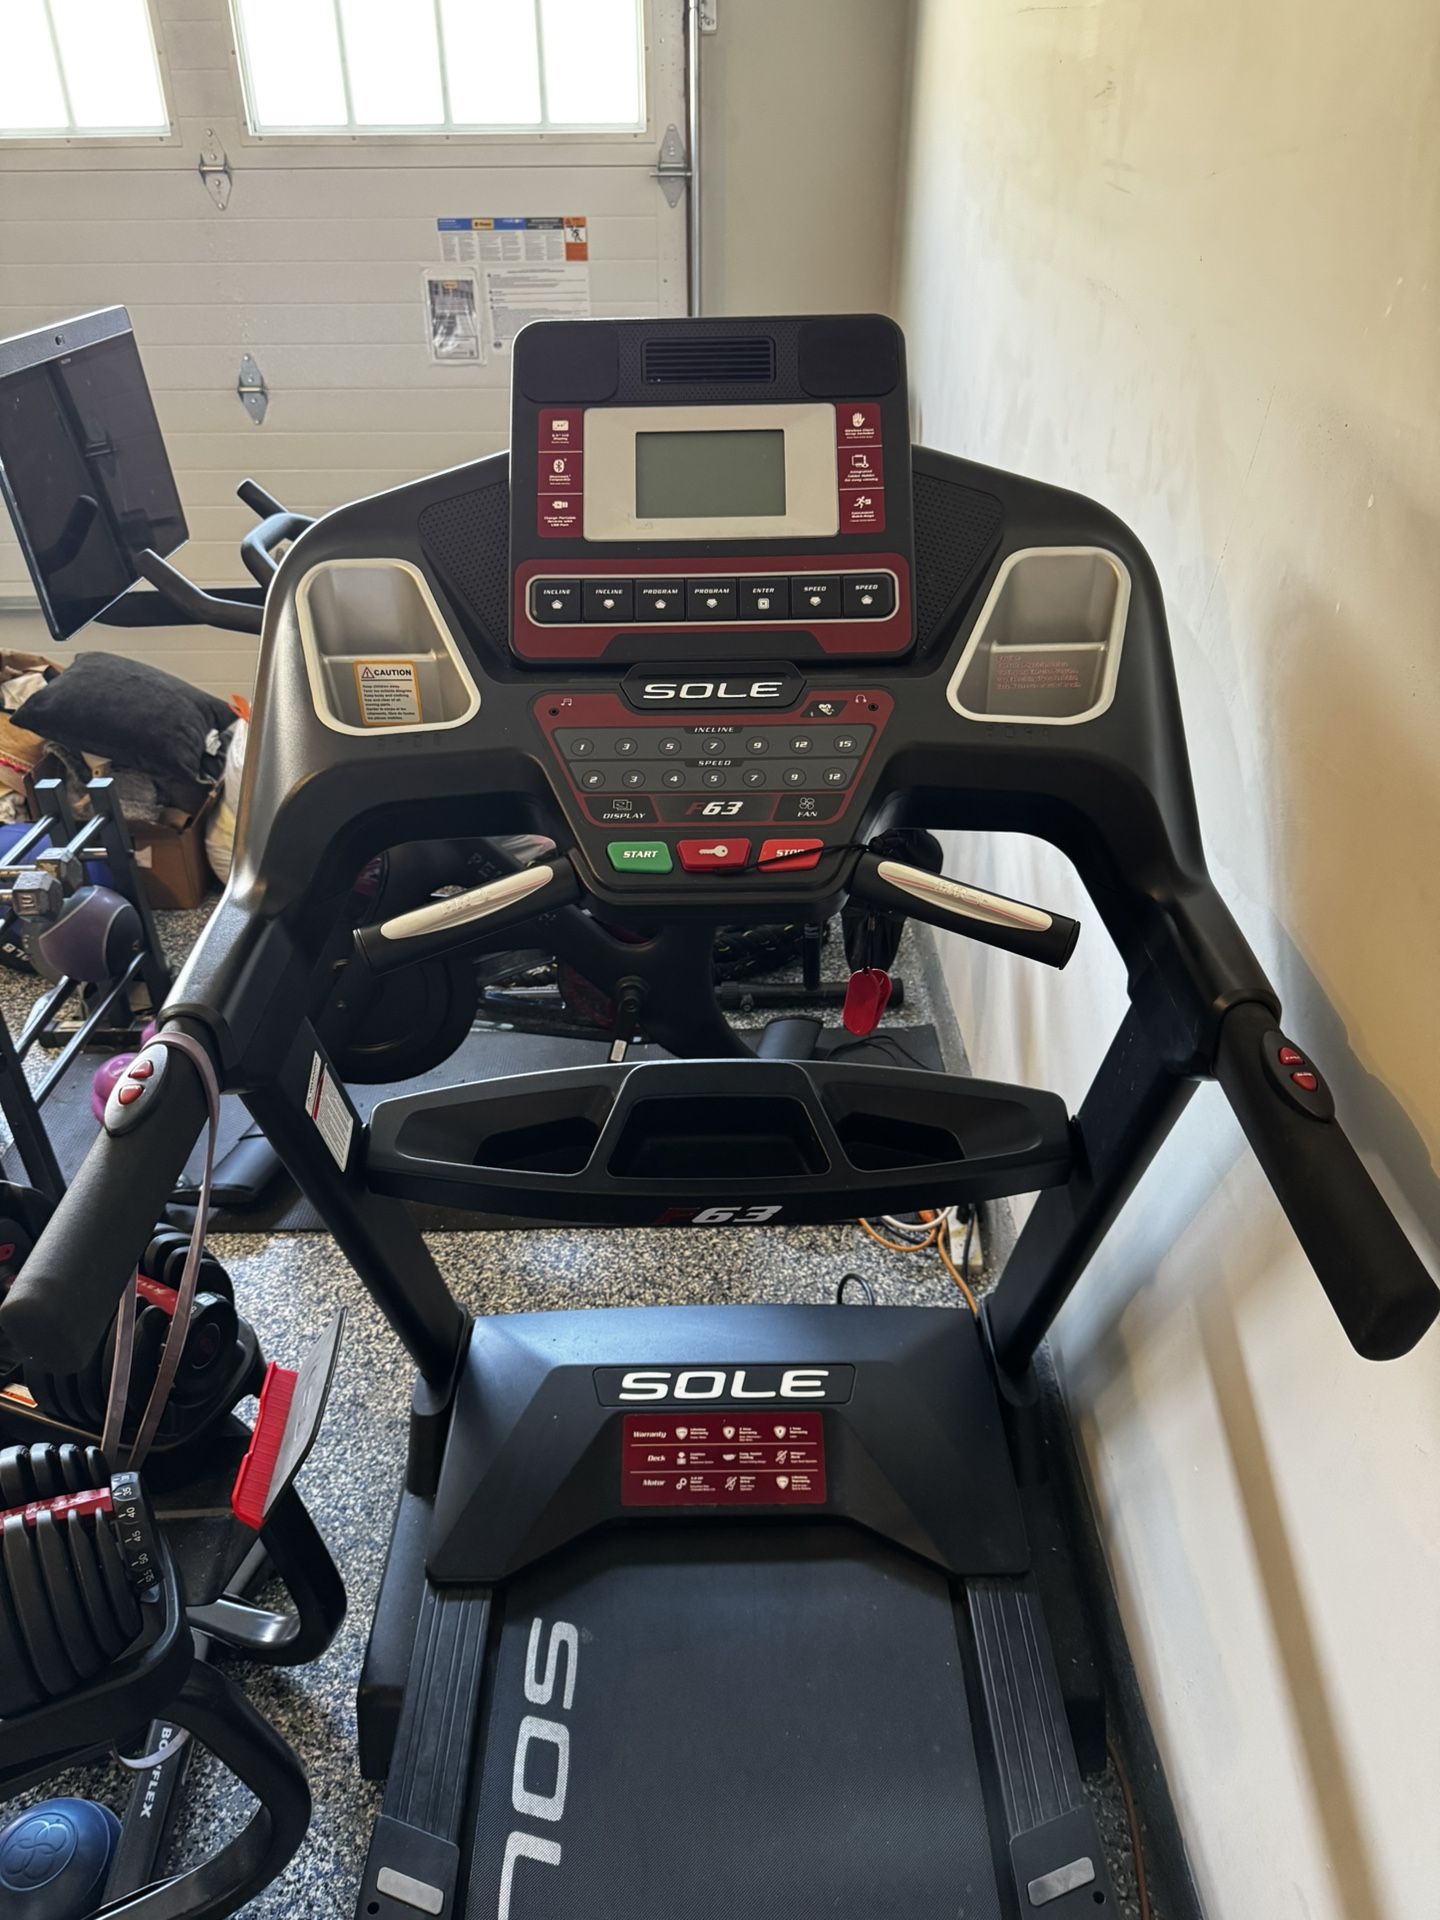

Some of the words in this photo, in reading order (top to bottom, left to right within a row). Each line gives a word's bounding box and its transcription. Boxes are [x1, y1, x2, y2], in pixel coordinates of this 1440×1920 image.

[643, 681, 783, 699] SOLE
[686, 801, 744, 816] F63
[622, 850, 659, 859] START
[655, 1205, 783, 1225] F63
[619, 1370, 829, 1400] SOLE
[633, 1431, 667, 1439] Warranty
[125, 1507, 136, 1518] 40
[132, 1530, 142, 1542] 45
[139, 1553, 149, 1565] 50
[140, 1727, 173, 1818] BOFLEX
